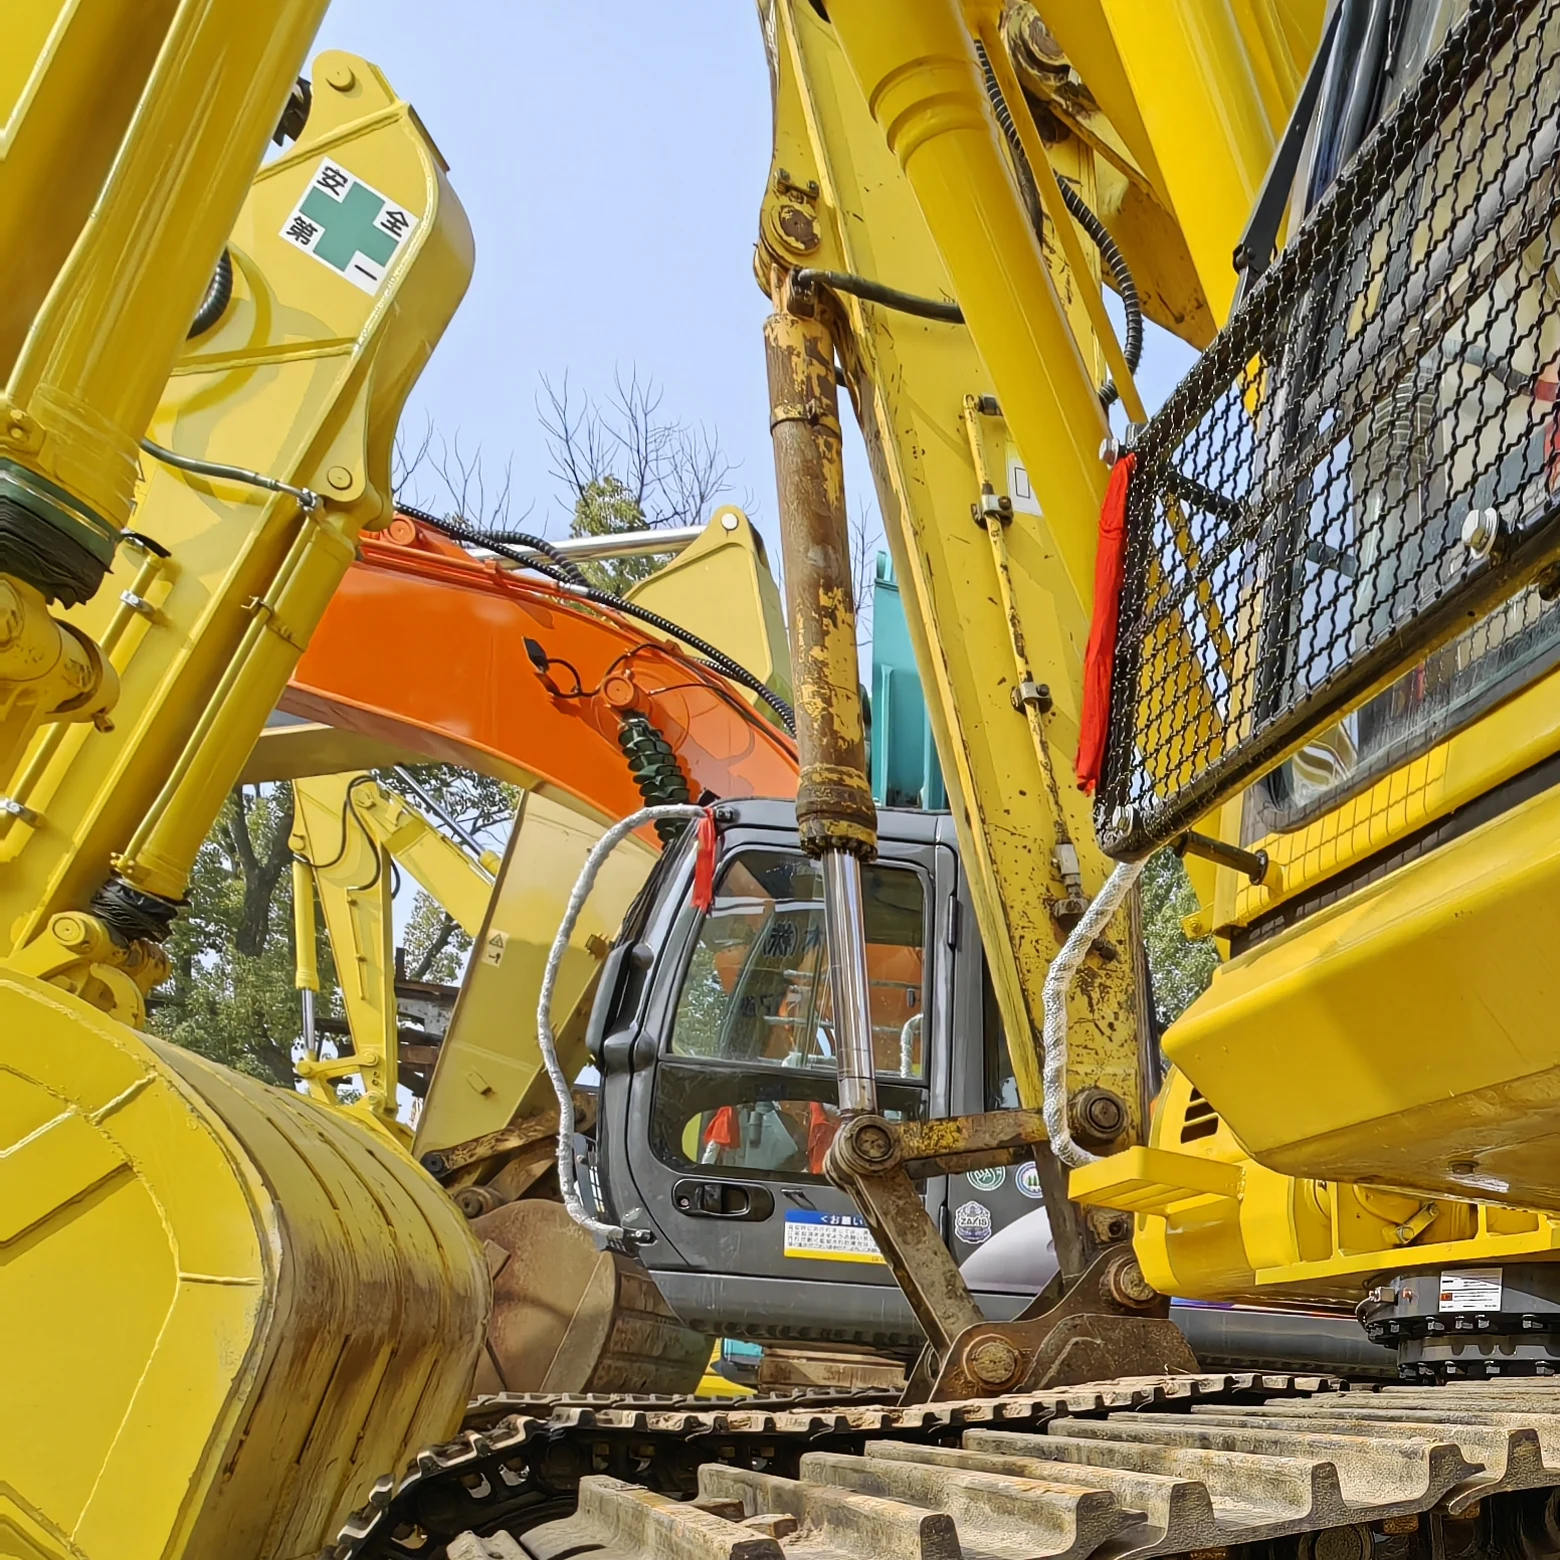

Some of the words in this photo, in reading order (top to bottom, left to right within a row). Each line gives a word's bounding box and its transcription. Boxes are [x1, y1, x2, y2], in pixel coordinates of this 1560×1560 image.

[316, 166, 348, 196] 安
[381, 210, 409, 238] 全
[286, 216, 318, 246] 第
